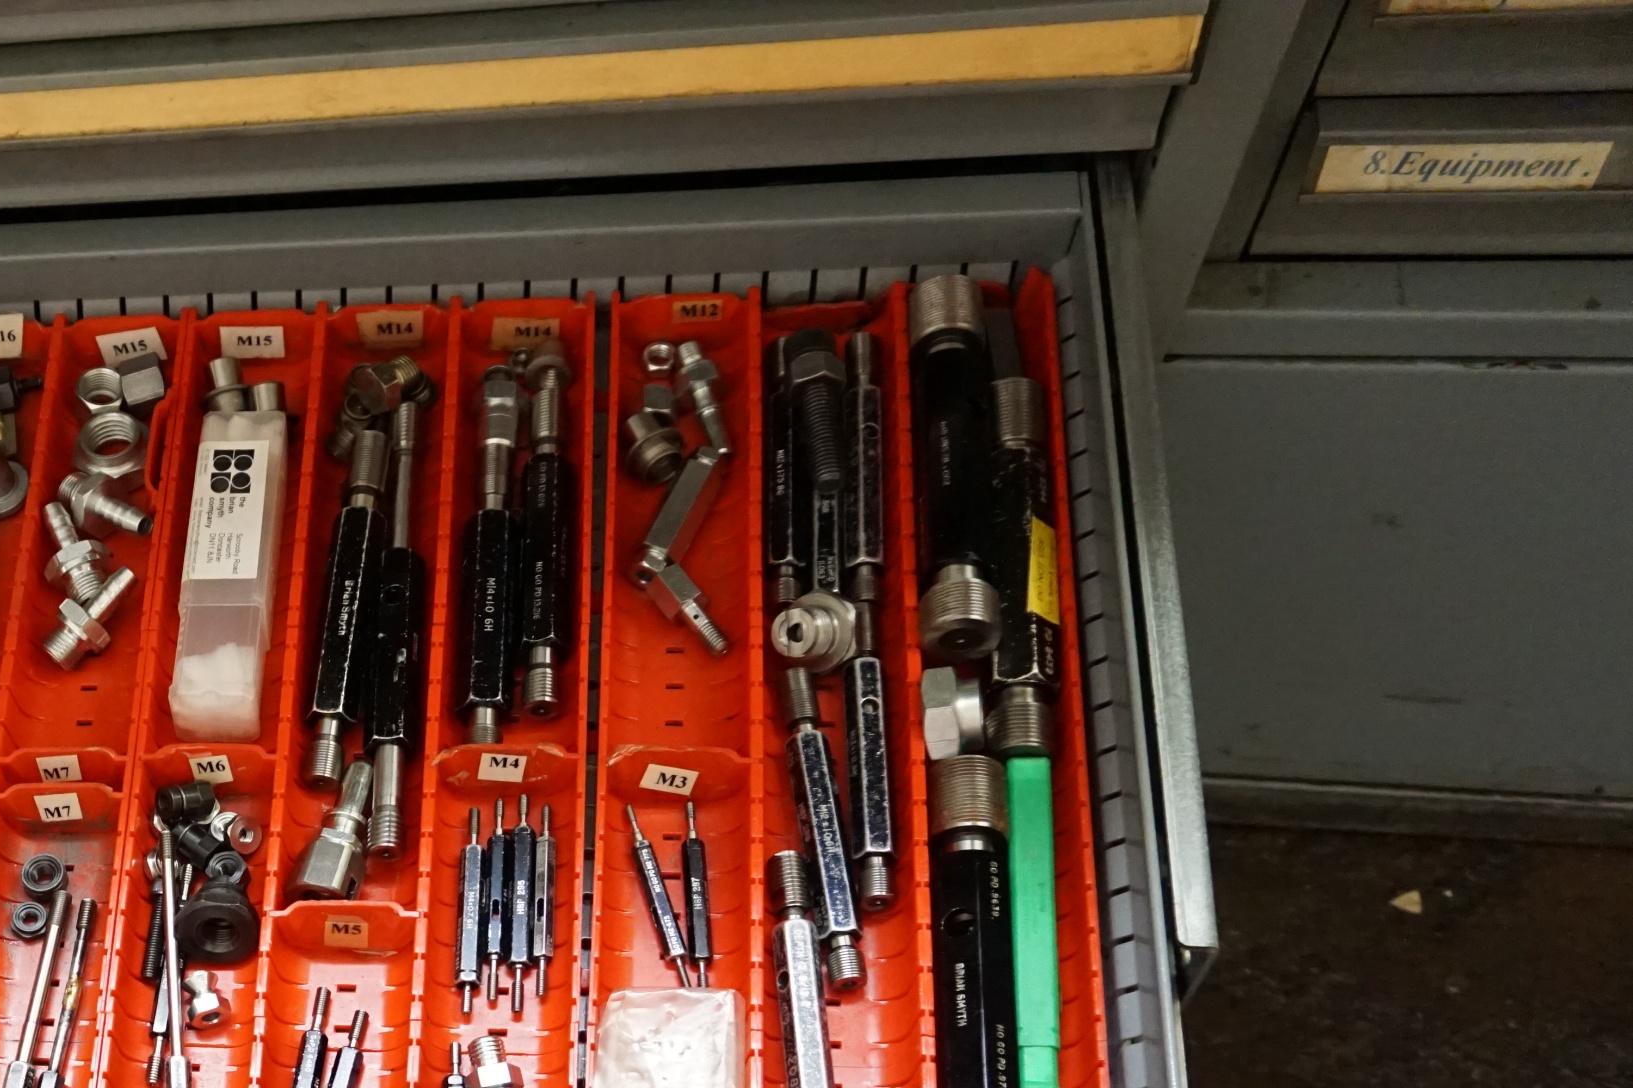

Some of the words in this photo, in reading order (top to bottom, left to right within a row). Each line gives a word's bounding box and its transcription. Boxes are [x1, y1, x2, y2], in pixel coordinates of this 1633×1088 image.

[680, 303, 719, 318] M12
[377, 322, 413, 335] M14
[514, 325, 551, 337] M14
[113, 339, 148, 356] M15
[237, 335, 273, 346] M15
[217, 496, 226, 518] smyth
[227, 496, 236, 514] brian
[238, 496, 246, 508] the
[204, 495, 215, 529] company
[196, 760, 226, 774] M6
[490, 756, 520, 768] M4
[43, 767, 69, 780] M7
[657, 772, 688, 788] M3
[44, 805, 71, 819] M7
[517, 879, 526, 895] 295
[331, 923, 362, 935] M5
[954, 962, 965, 992] BRIAN
[955, 993, 967, 1026] SMYTH
[996, 1024, 1004, 1038] NO
[997, 1056, 1005, 1070] PD
